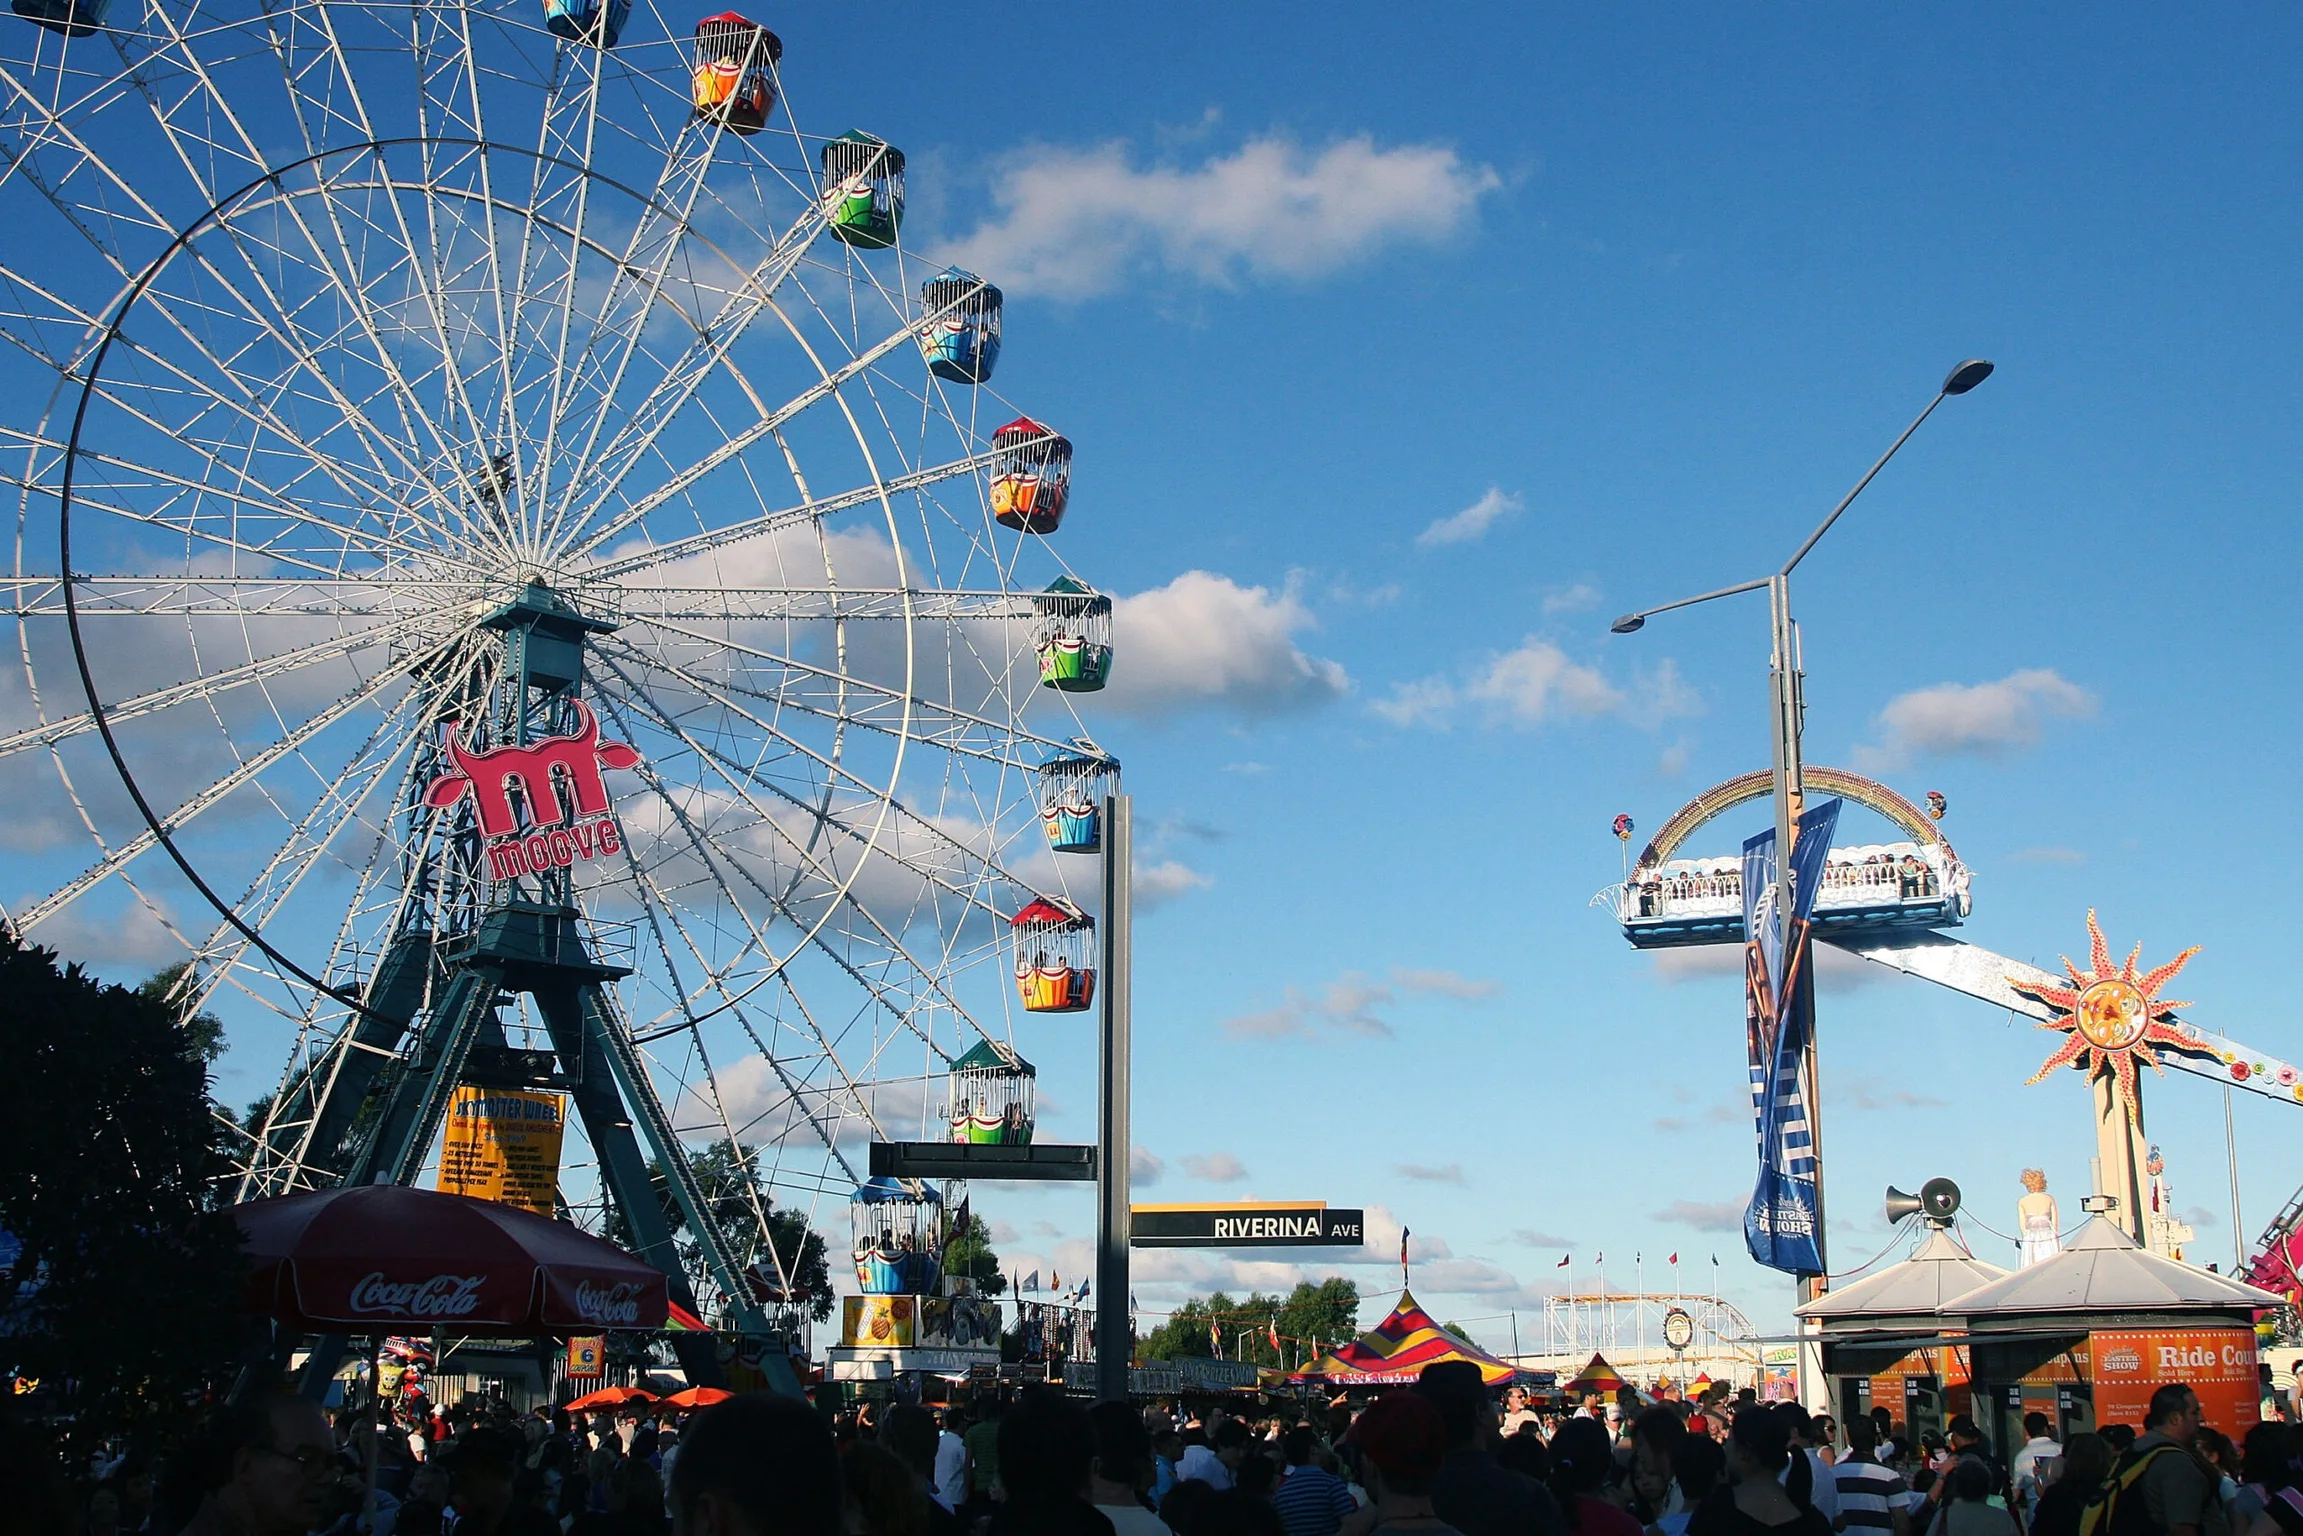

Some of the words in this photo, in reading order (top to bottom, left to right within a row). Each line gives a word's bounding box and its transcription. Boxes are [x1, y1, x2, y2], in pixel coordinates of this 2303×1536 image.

[487, 819, 621, 882] moove
[455, 1097, 522, 1118] SKYMASTER
[1213, 1216, 1321, 1239] RIVERINA
[1330, 1224, 1360, 1237] AVE
[2103, 1361, 2139, 1371] SHOW
[2157, 1345, 2216, 1367] Ride
[2157, 1369, 2177, 1377] Sold
